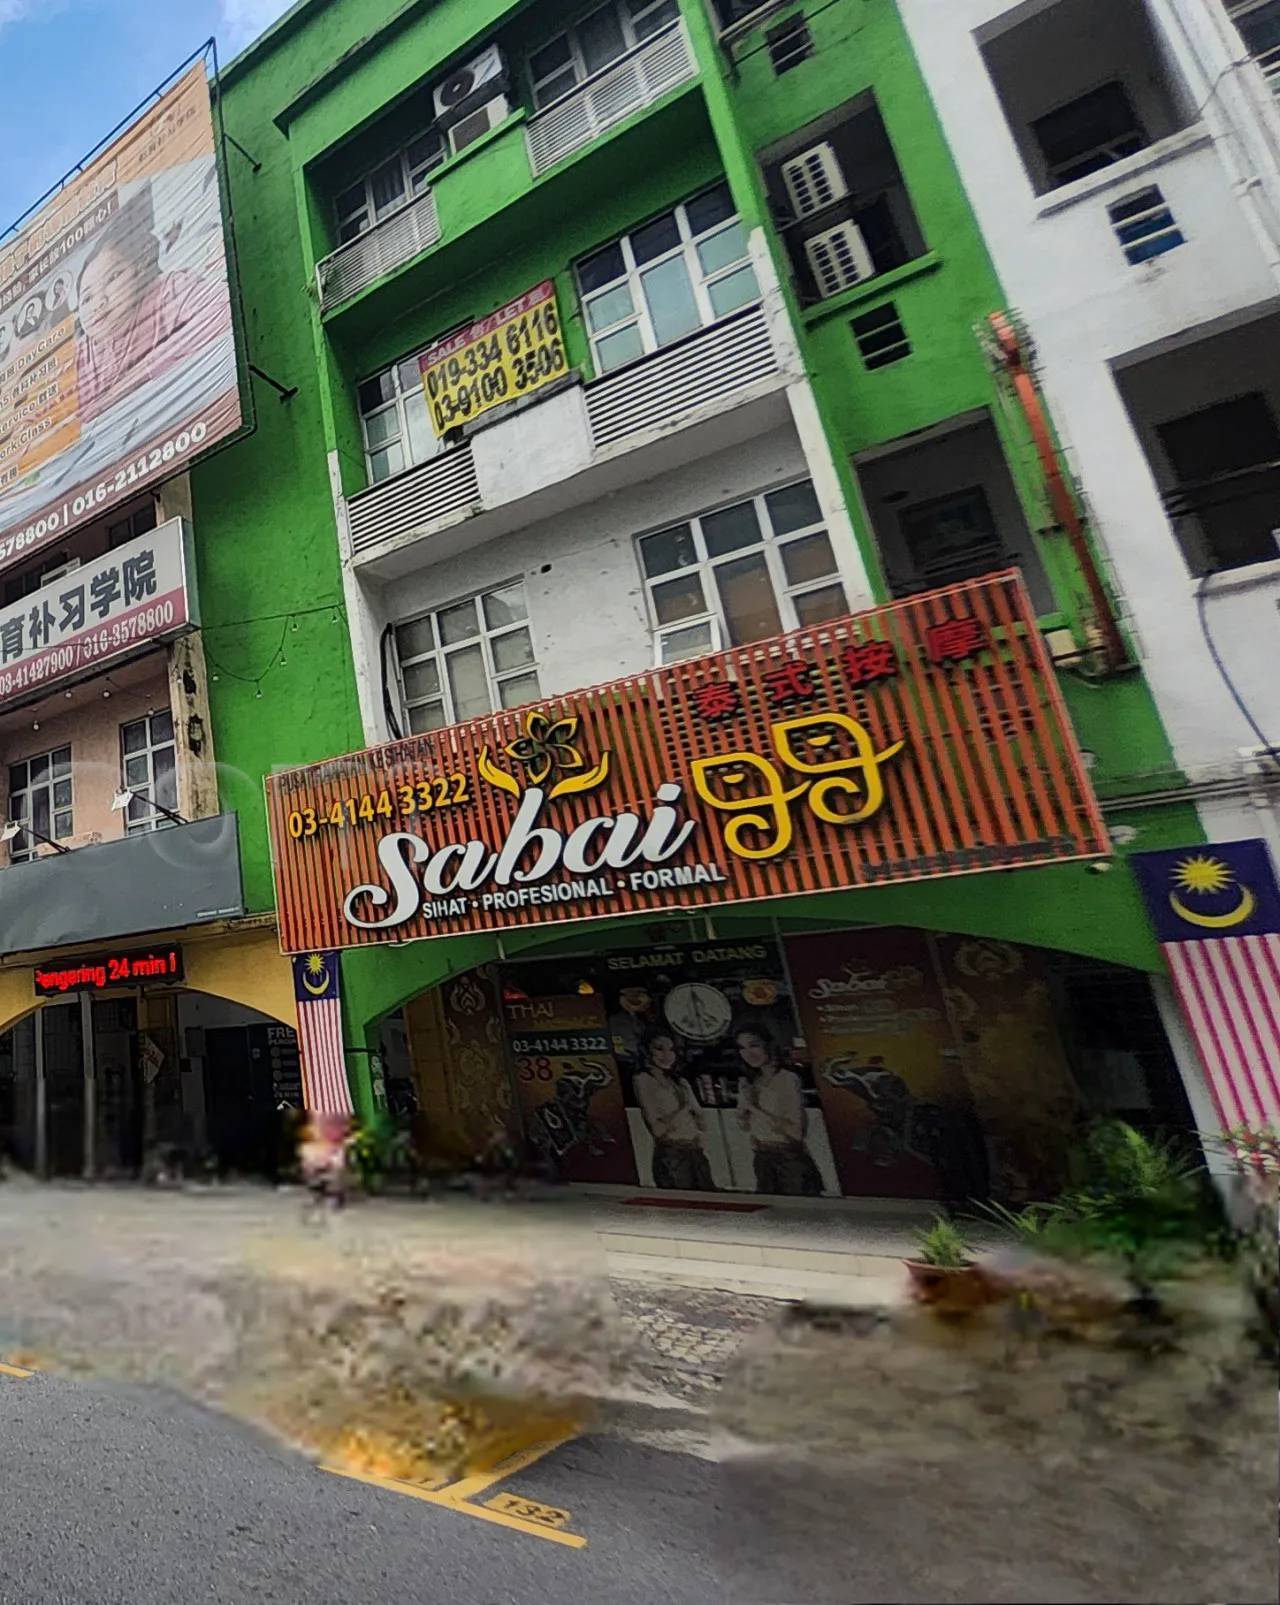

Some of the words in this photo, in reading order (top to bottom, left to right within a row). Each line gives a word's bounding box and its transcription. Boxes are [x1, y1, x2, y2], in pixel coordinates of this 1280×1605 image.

[427, 338, 466, 365] SALE
[19, 417, 52, 444] Class
[72, 421, 208, 516] 016-2112800
[83, 600, 173, 659] 016-3578800
[694, 616, 986, 718] 泰式按摩
[288, 789, 393, 839] 03-4144
[399, 773, 470, 815] 3322
[344, 783, 696, 929] Sabai
[422, 897, 470, 919] SIHAT
[482, 877, 613, 912] PROFESIONAL
[630, 862, 726, 891] FORMAL
[108, 957, 130, 981] 24
[132, 954, 167, 977] min
[607, 952, 685, 970] SELAMAT
[692, 944, 768, 963] DATANG
[504, 1001, 554, 1020] THAI
[512, 1037, 570, 1052] 03-4144
[571, 1035, 608, 1051] 3322
[517, 1056, 553, 1082] 38
